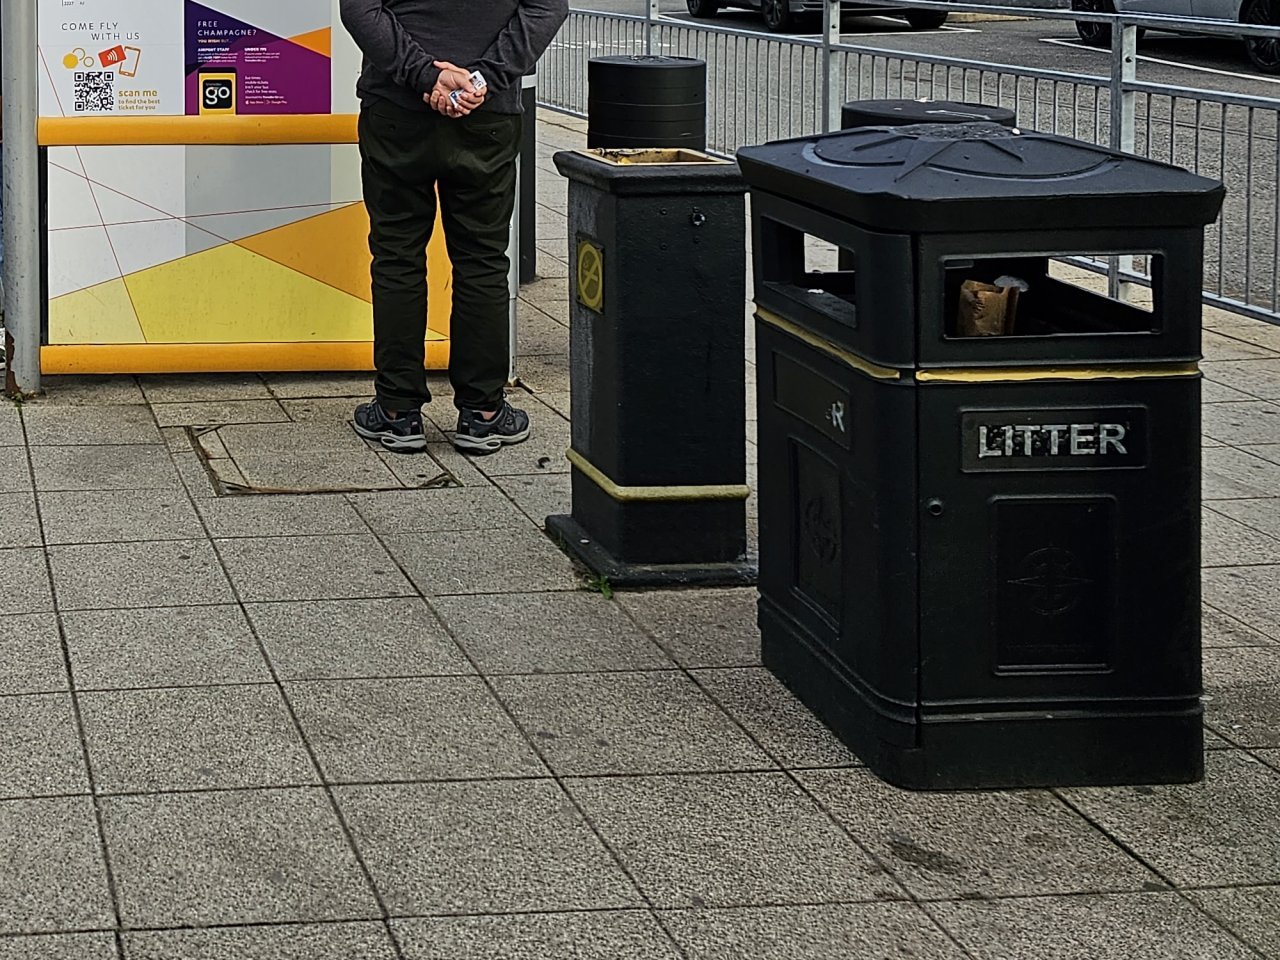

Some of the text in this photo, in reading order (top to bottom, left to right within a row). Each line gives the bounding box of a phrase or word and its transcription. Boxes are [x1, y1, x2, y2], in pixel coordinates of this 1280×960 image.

[100, 22, 118, 30] FLY
[126, 32, 140, 40] US
[206, 86, 230, 104] go
[978, 423, 1128, 459] LITTER
